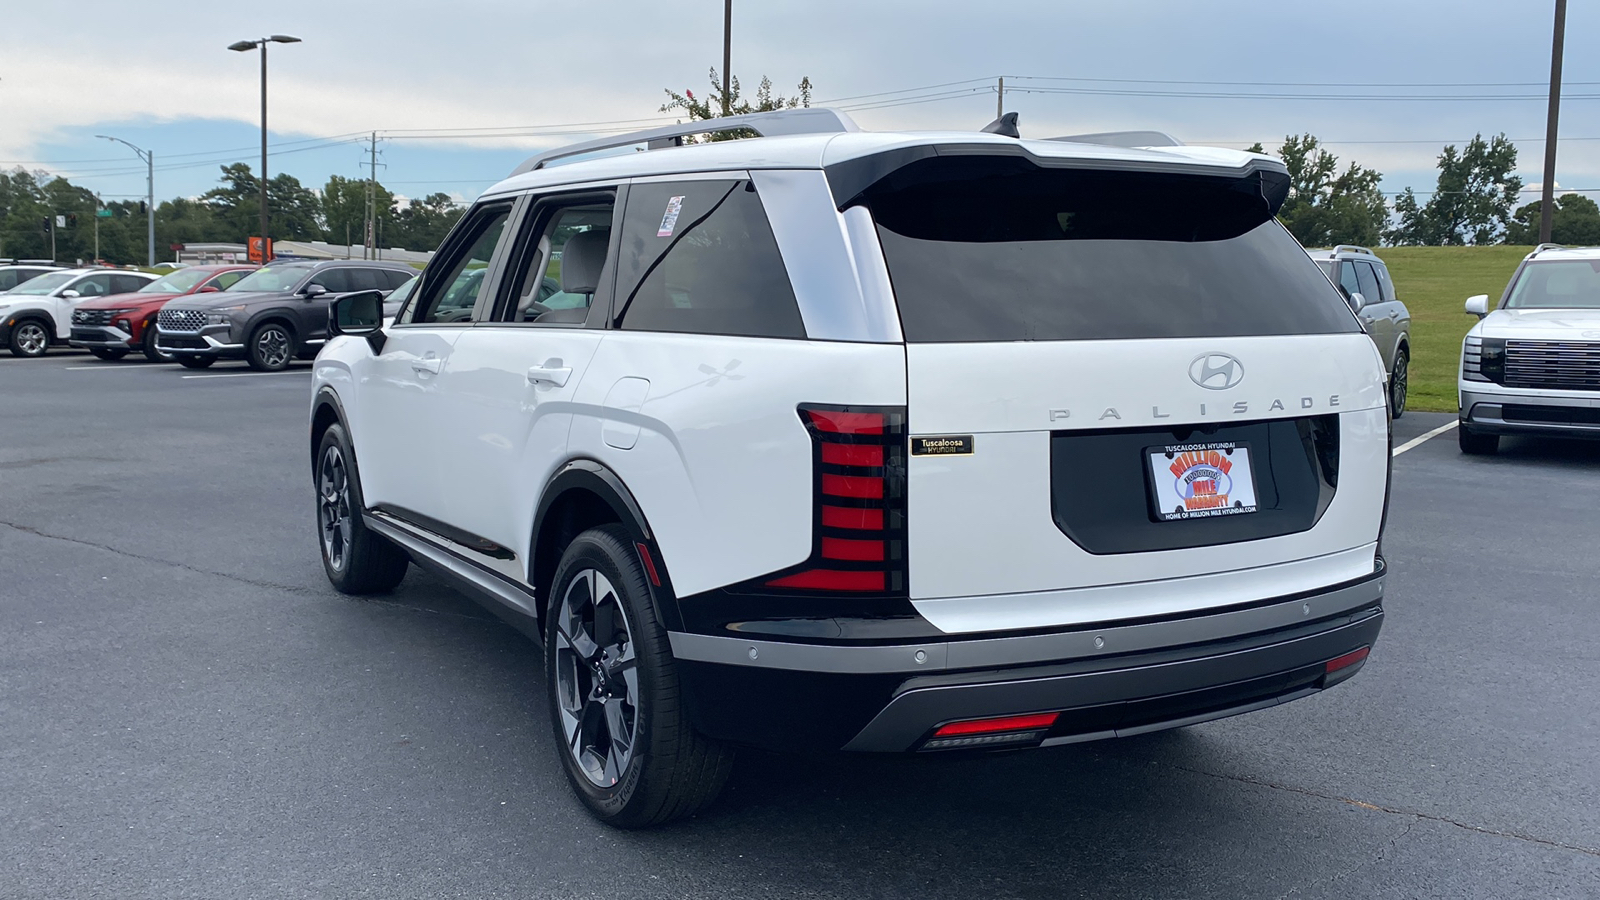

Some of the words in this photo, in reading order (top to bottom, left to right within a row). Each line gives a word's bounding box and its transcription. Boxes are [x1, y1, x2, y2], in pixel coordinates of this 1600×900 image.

[1049, 395, 1340, 422] PALISADE
[921, 438, 963, 447] Tuscaloosa
[1165, 444, 1206, 452] TUSCALOOSA
[1169, 450, 1232, 479] MILLION
[1193, 480, 1217, 496] MILE
[1185, 494, 1228, 510] WARRANTY
